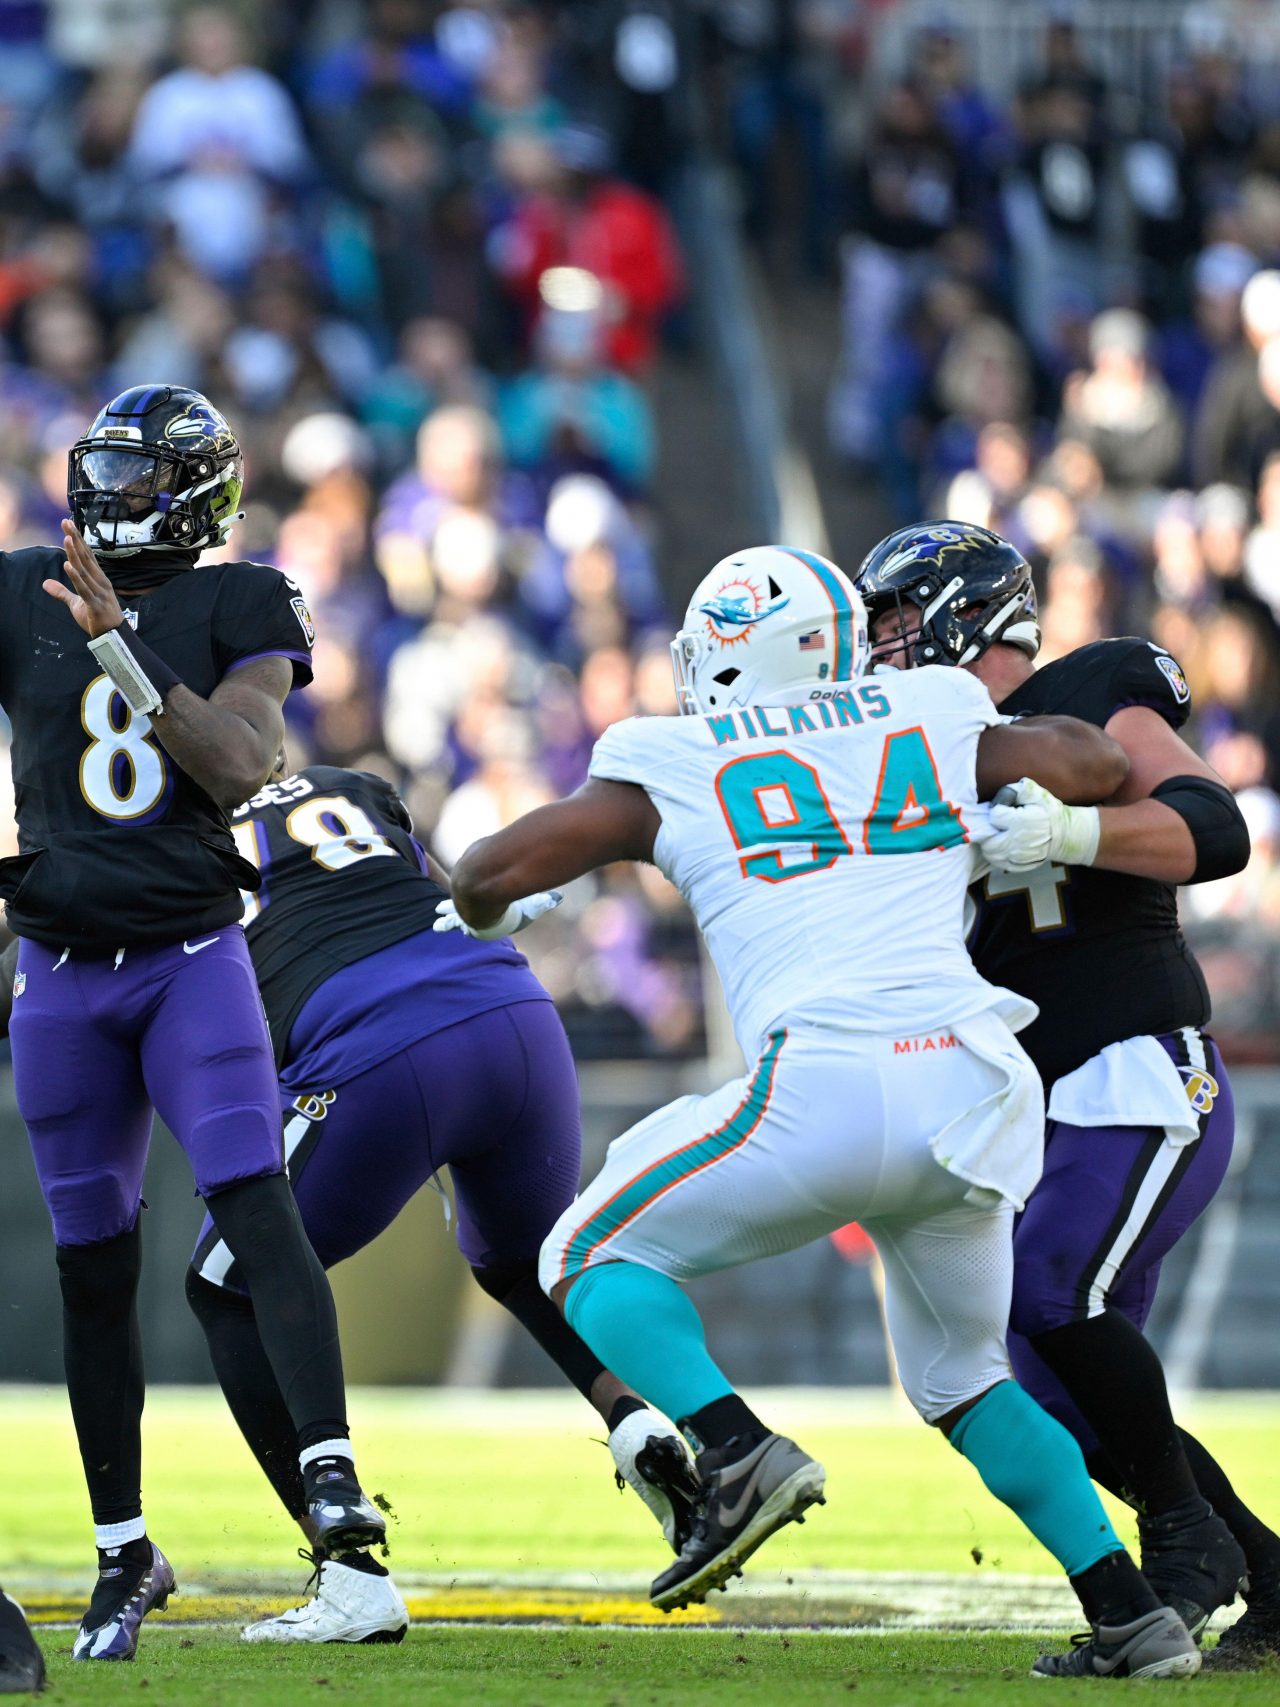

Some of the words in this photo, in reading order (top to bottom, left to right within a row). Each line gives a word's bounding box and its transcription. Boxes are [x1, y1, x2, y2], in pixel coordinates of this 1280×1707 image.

[704, 685, 892, 745] WILKINS
[79, 673, 167, 820] 8
[232, 775, 314, 818] SES
[715, 725, 970, 884] 94
[894, 1032, 962, 1054] MIAM
